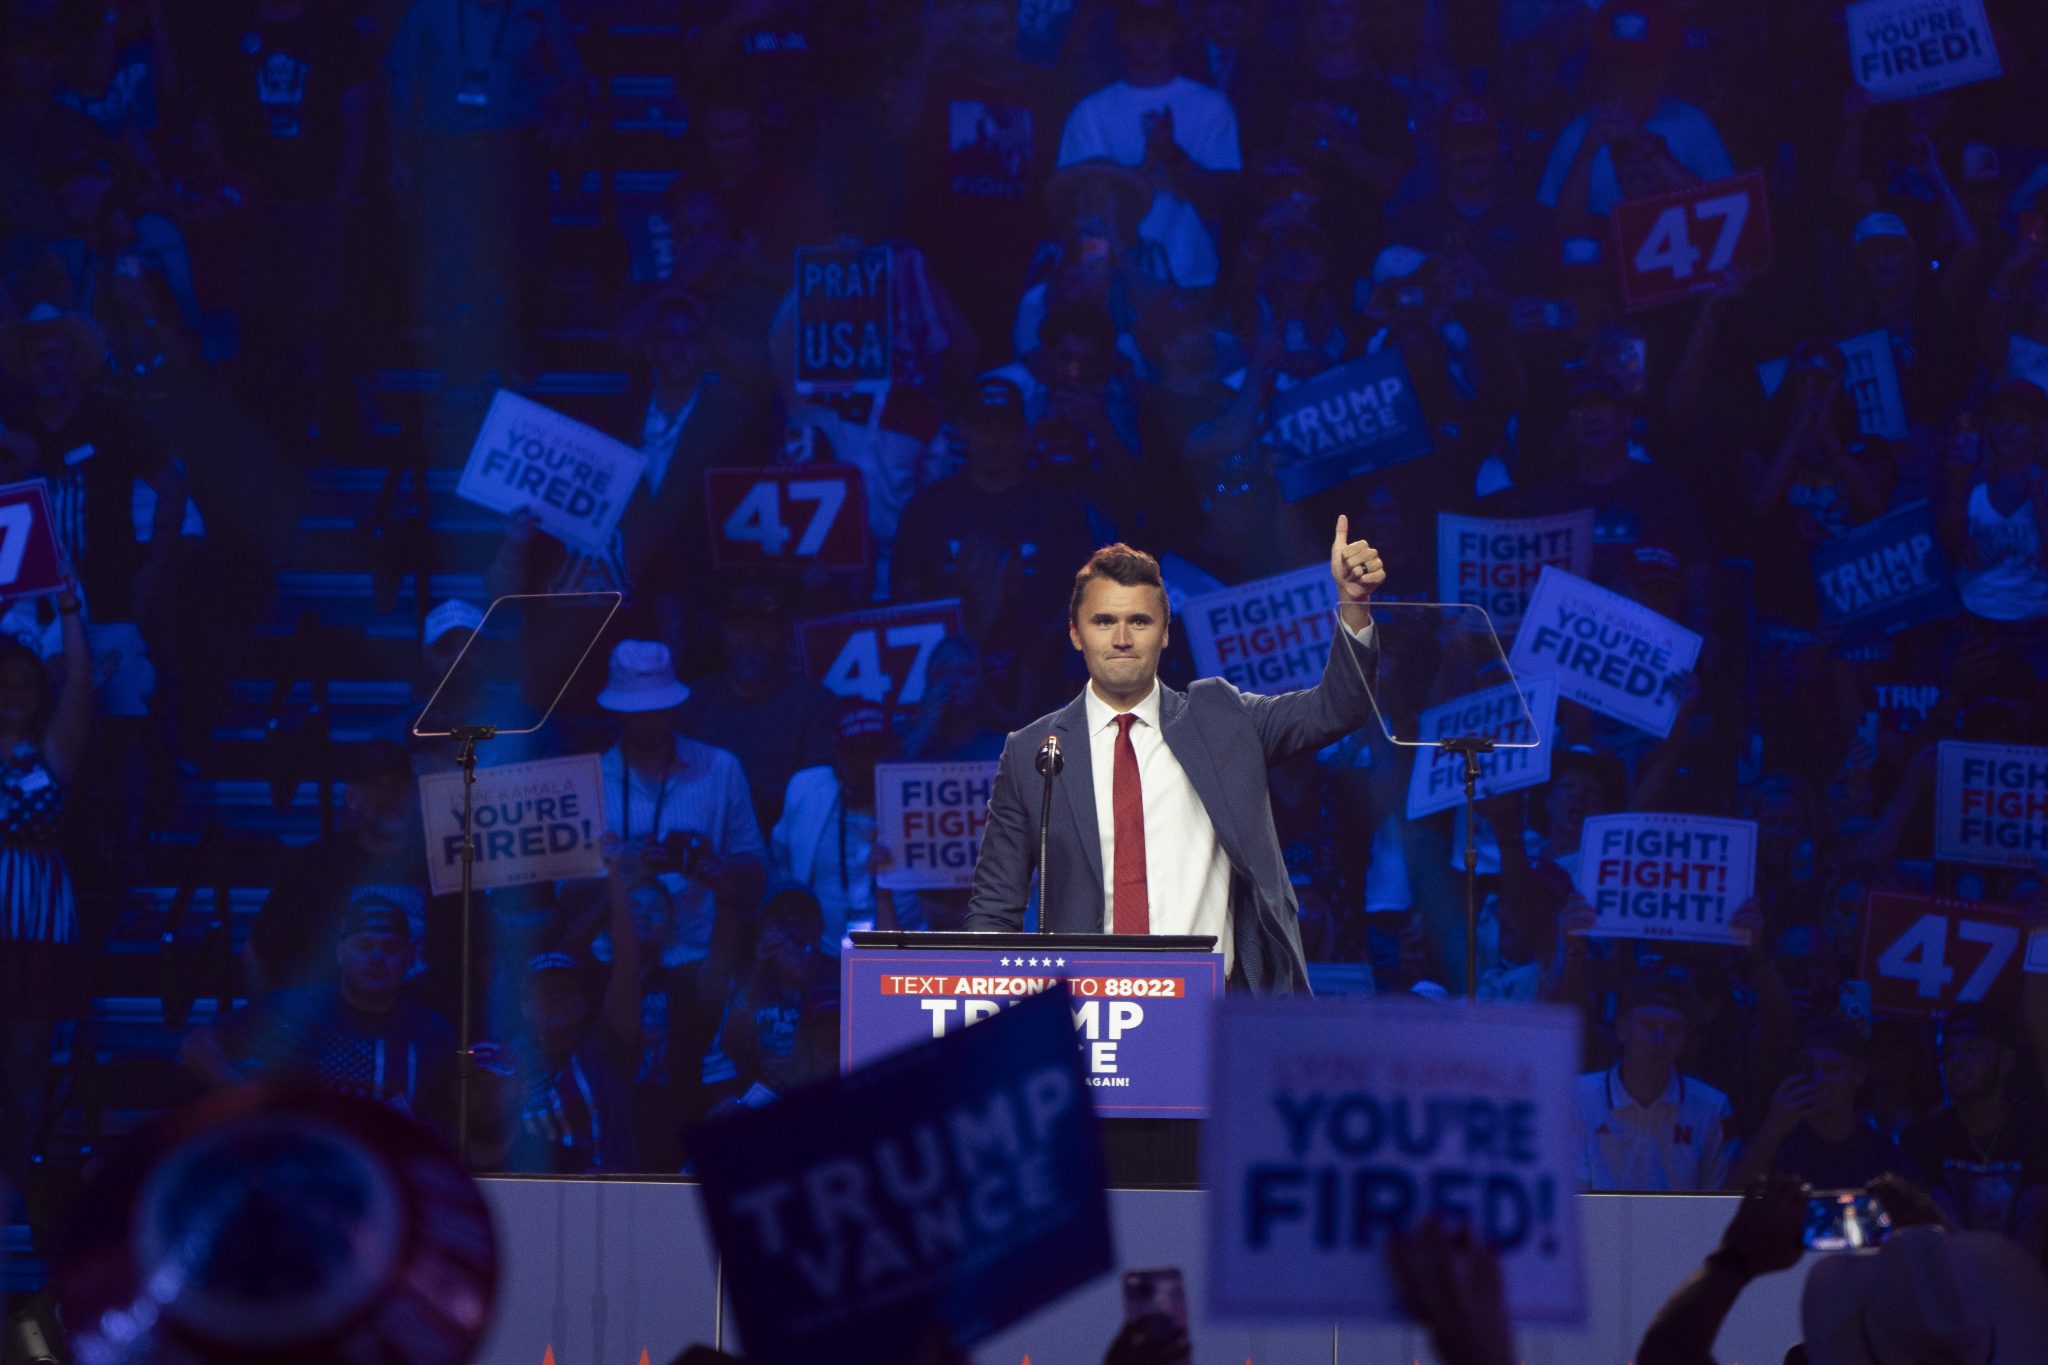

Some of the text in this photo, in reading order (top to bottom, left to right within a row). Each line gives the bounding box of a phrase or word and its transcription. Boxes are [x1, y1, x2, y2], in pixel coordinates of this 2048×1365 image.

[1861, 26, 1982, 82] FIRED!
[1866, 8, 1965, 48] YOU'RE
[1635, 192, 1749, 279] 47
[804, 262, 885, 299] PRAY
[806, 322, 884, 370] USA
[1279, 376, 1403, 441] TRUMP
[1293, 404, 1399, 457] VANCE
[507, 428, 615, 496] YOU'RE
[479, 449, 612, 528] FIRED!
[723, 480, 848, 557] 47
[1457, 527, 1572, 564] FIGHT!
[1821, 532, 1933, 597] TRUMP
[1457, 559, 1545, 591] FIGH
[1834, 562, 1928, 614] VANCE
[1208, 581, 1330, 638] FIGHT!
[822, 621, 947, 705] 47
[1530, 625, 1677, 706] FIRED!
[1555, 607, 1674, 672] YOU'RE
[1437, 690, 1535, 739] FIGHT!
[452, 793, 580, 829] YOU'RE
[497, 778, 576, 801] KAMALA
[443, 819, 593, 866] FIRED!
[1601, 829, 1729, 862] FIGHT!
[1596, 859, 1727, 893] FIGHT!
[1594, 890, 1725, 924] FIGHT!
[1877, 914, 2020, 1004] 47
[890, 976, 948, 994] TEXT
[1066, 978, 1098, 996] TO
[1104, 978, 1176, 997] 88022
[920, 999, 1144, 1040] TRMP
[1086, 1077, 1130, 1087] AGAIN!
[1273, 1090, 1537, 1163] YOU'RE
[1674, 1126, 1693, 1146] N
[730, 1067, 1074, 1257] TRUMP
[793, 1154, 1056, 1298] VANCE
[1245, 1164, 1559, 1256] FIRED!
